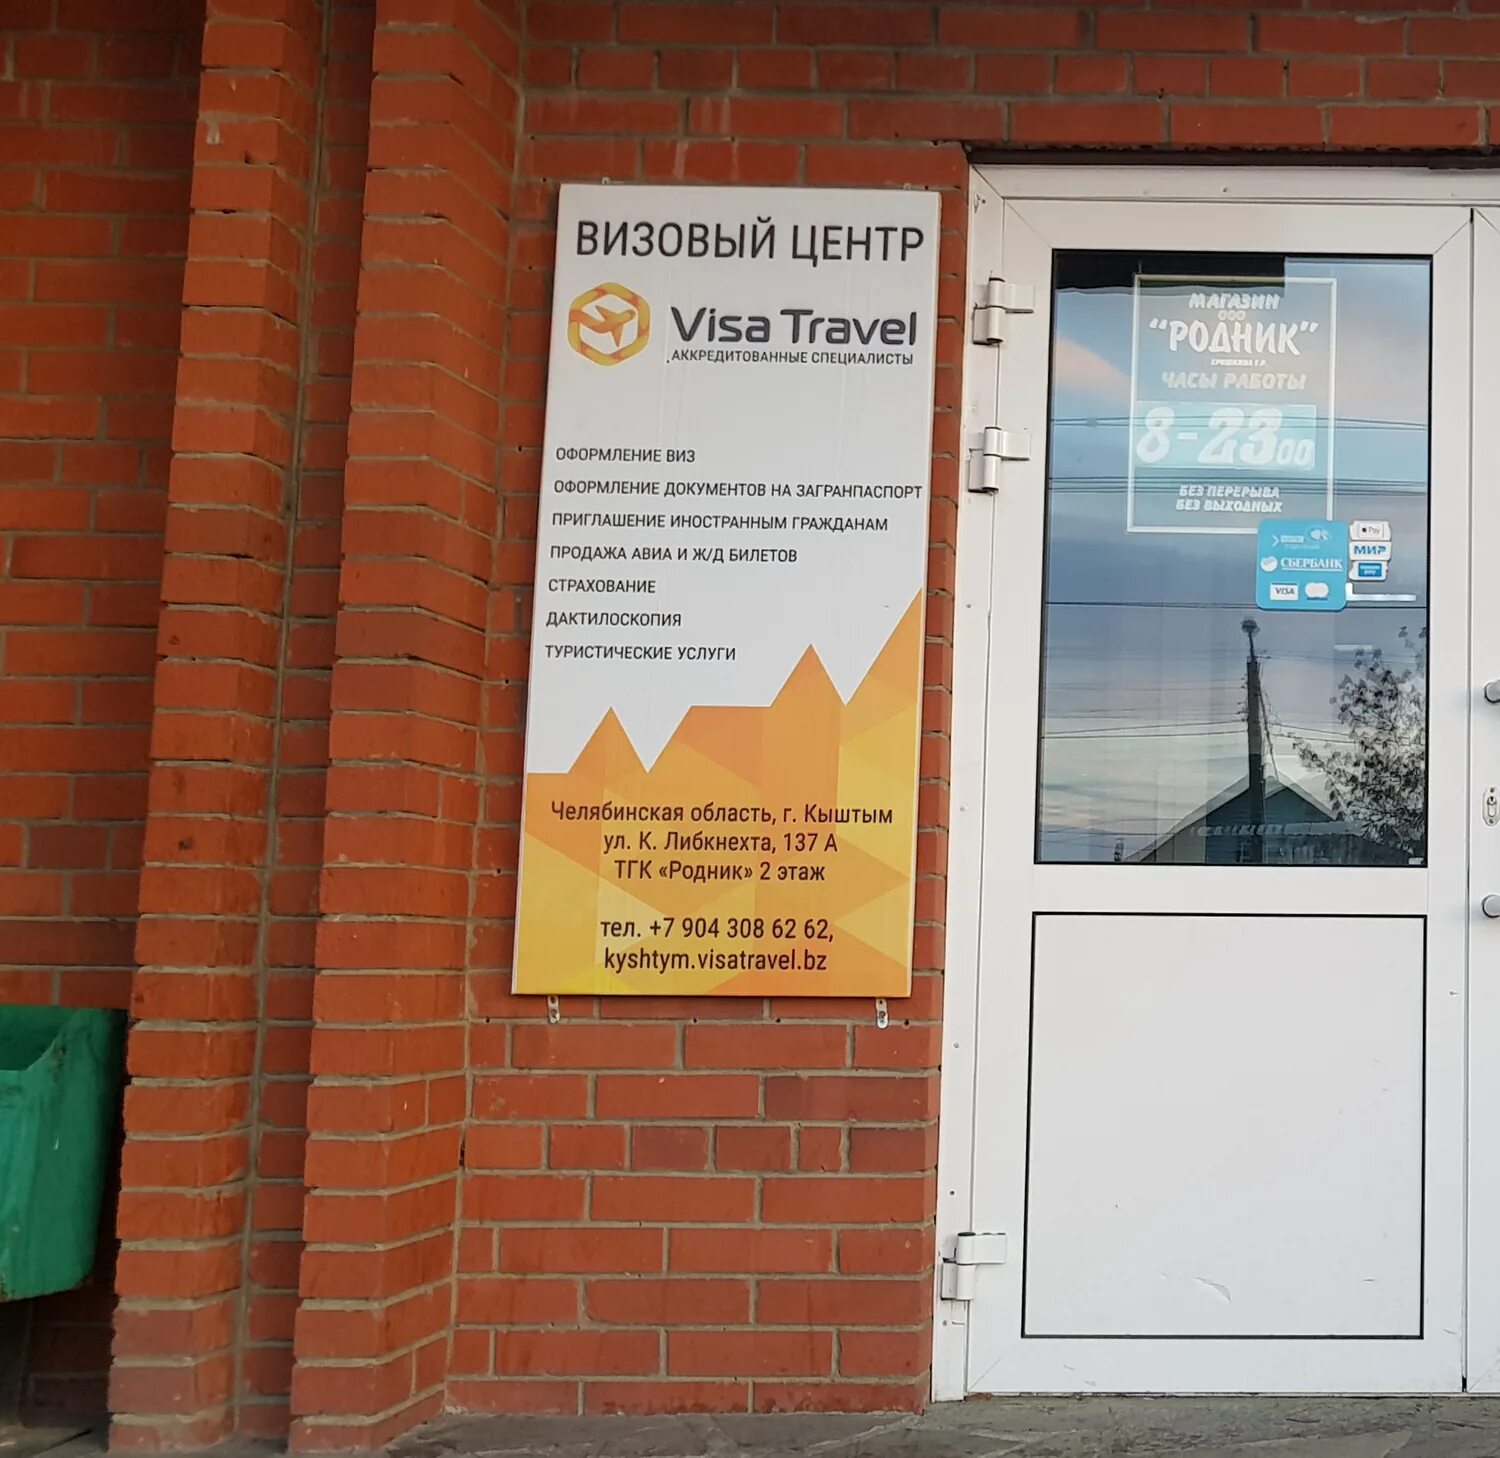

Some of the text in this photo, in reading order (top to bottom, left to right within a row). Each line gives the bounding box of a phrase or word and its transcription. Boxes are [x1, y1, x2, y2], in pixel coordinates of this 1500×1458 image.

[576, 216, 924, 268] ВИЗОВЫЙ ЦЕНТР
[1189, 293, 1279, 309] МАГАЗИН
[1218, 309, 1245, 321] ООО
[670, 307, 917, 345] Visa Travel
[671, 351, 913, 366] АККРЕДИТОВАННЫЕ СПЕЦИАЛИСТЫ
[1162, 373, 1307, 389] ЧАСЫ РАБОТЫ
[556, 447, 696, 463] ОФОРМЛЕНИЕ ВИЗ
[554, 480, 923, 499] ОФОРМЛЕНИЕ ДОКУМЕНТОВ НА ЗАГРАНПАСПОРТ
[1180, 485, 1280, 498] БЕЗ ПЕРЕРЫВА
[1176, 500, 1282, 513] БЕЗ ВЫХОДНЫХ
[552, 513, 888, 532] ПРИГЛАШЕНИЕ ИНОСТРАННЫМ ГРАЖДАНАМ
[550, 545, 797, 564] ПРОДАЖА АВИА И Ж/Д БИЛЕТОВ
[1354, 546, 1386, 555] МИР
[1281, 557, 1342, 568] СБЕРБАНК
[548, 579, 656, 594] СТРАХОВАНИЕ
[546, 612, 681, 628] ДАКТИЛОСКОПИЯ
[545, 645, 736, 661] ТУРИСТИЧЕСКИЕ УСЛУГИ
[551, 801, 893, 825] Челябинская область, г. Кыштым
[603, 833, 837, 854] ул. К. Либкнехта, 137 А
[614, 860, 825, 882] ТГК «Родник» 2 этаж
[600, 918, 833, 942] тел. +7 904 308 62 62,
[604, 948, 827, 973] kyshtym.visatravel.bz
